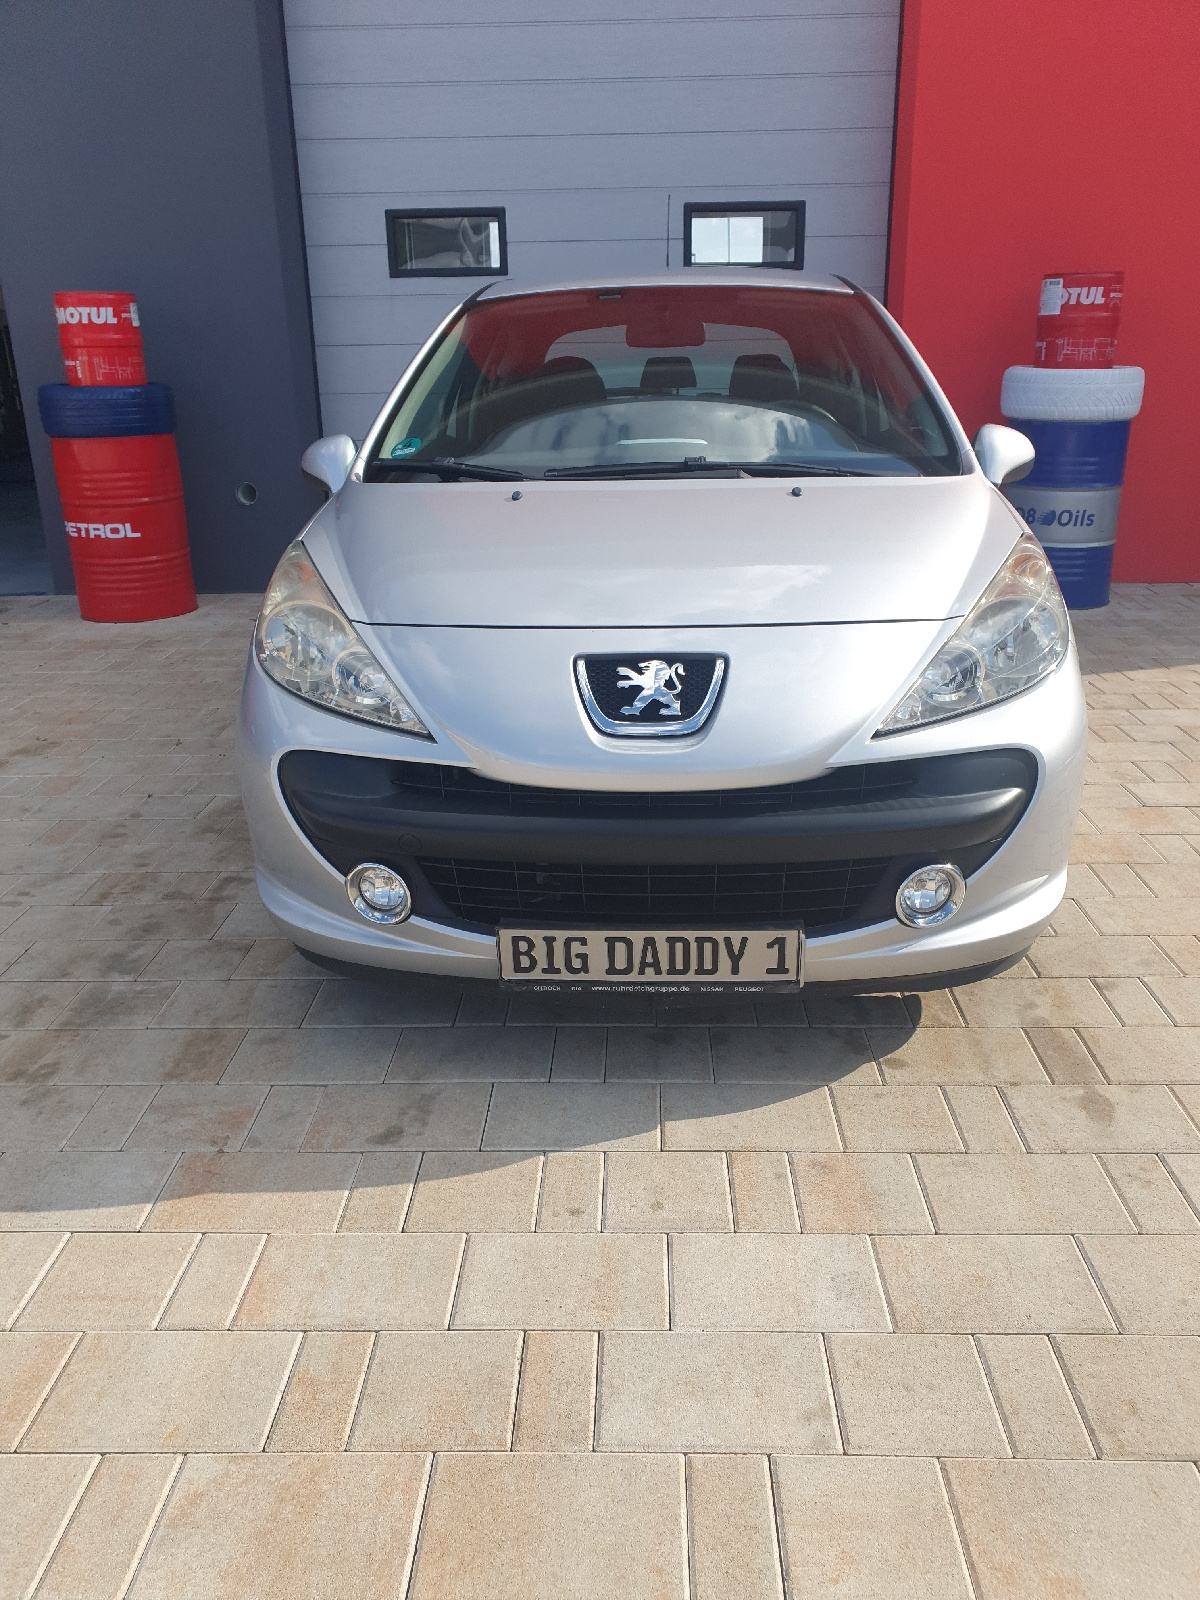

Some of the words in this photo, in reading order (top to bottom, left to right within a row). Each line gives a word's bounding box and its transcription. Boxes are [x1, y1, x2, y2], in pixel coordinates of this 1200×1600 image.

[1060, 287, 1106, 305] OTUL
[1057, 509, 1096, 528] Oils
[511, 935, 590, 975] BIG
[604, 936, 749, 976] DADDY
[765, 936, 790, 975] 1
